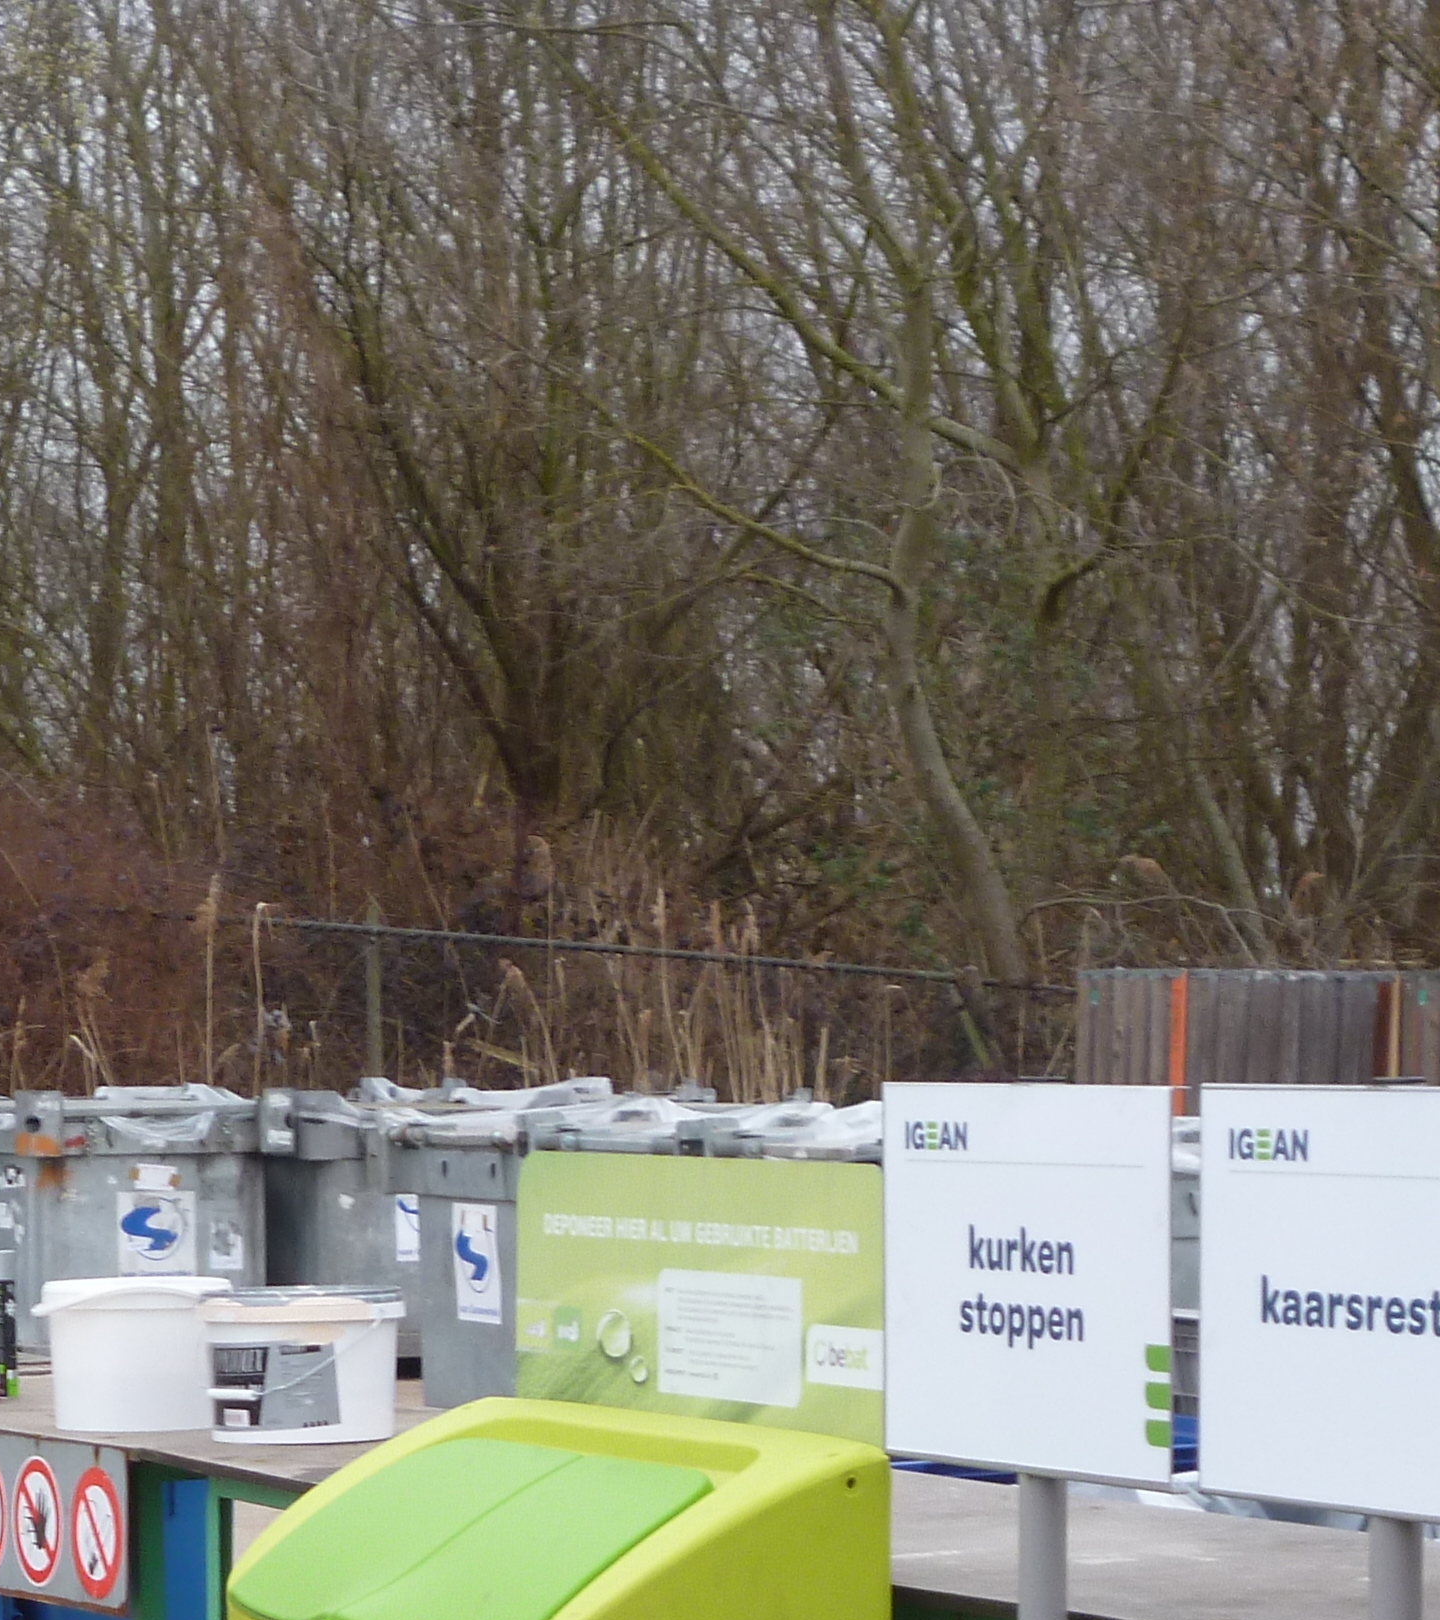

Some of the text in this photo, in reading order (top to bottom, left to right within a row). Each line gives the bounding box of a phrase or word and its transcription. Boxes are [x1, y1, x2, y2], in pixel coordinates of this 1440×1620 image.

[903, 1120, 969, 1152] IGEAN
[1228, 1127, 1310, 1163] IGEAN
[543, 1212, 613, 1238] DEPONEER
[615, 1216, 648, 1240] HIER
[649, 1218, 668, 1242] AL
[695, 1221, 772, 1249] GEBRUIKTE
[773, 1224, 860, 1254] BATTERIJEN
[967, 1224, 1075, 1277] kurken
[959, 1293, 1085, 1350] stoppen
